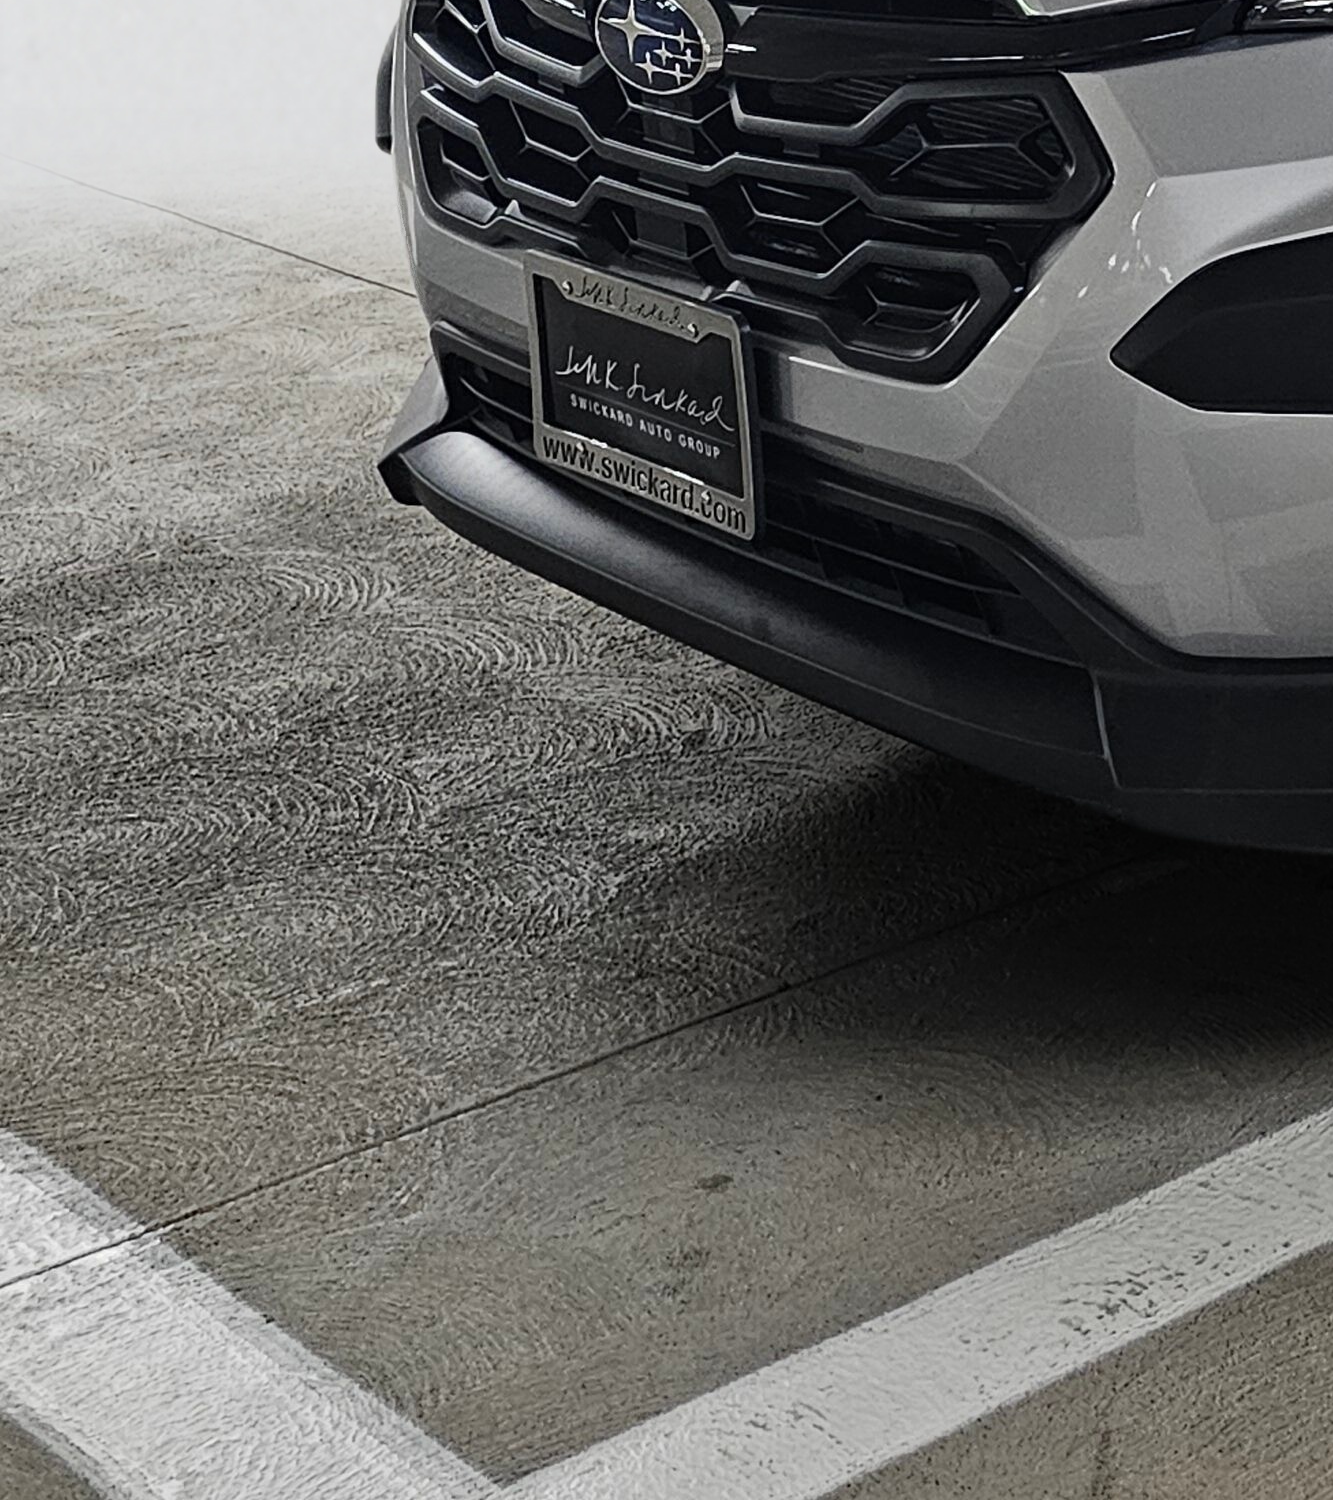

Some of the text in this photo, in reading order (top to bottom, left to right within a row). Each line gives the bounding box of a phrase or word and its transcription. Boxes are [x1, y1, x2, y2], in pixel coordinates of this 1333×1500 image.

[569, 393, 721, 460] SWICKARD AUTO GROUP
[542, 435, 747, 534] www.swickard.com
